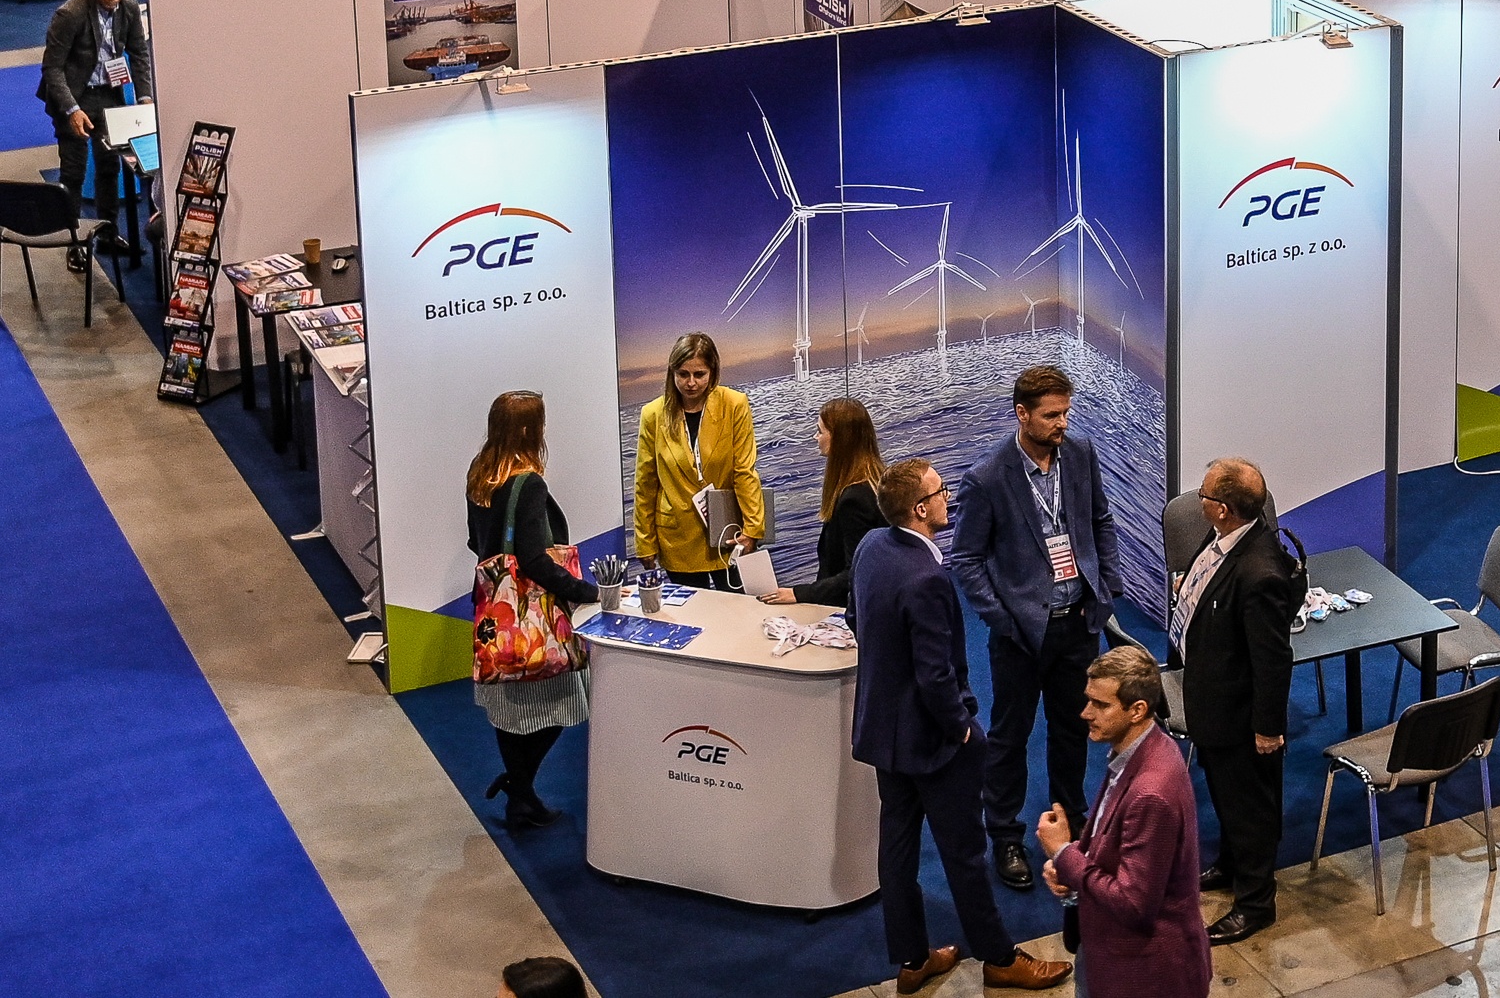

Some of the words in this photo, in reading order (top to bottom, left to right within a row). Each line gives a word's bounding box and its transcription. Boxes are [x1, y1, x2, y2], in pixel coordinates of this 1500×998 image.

[194, 144, 223, 155] POLISH
[1242, 185, 1326, 227] PGE
[441, 232, 540, 278] PGE
[1226, 248, 1277, 269] Baltica
[1282, 245, 1304, 261] sp.
[1308, 242, 1316, 254] z
[1321, 238, 1346, 252] o.o.
[425, 298, 486, 320] Baltica
[492, 294, 518, 312] sp.
[523, 291, 532, 304] z
[537, 286, 567, 302] o.o.
[677, 741, 730, 766] PGE
[668, 769, 701, 784] Baltica
[703, 776, 718, 788] sp.
[719, 779, 725, 788] z
[727, 781, 744, 791] o.o.
